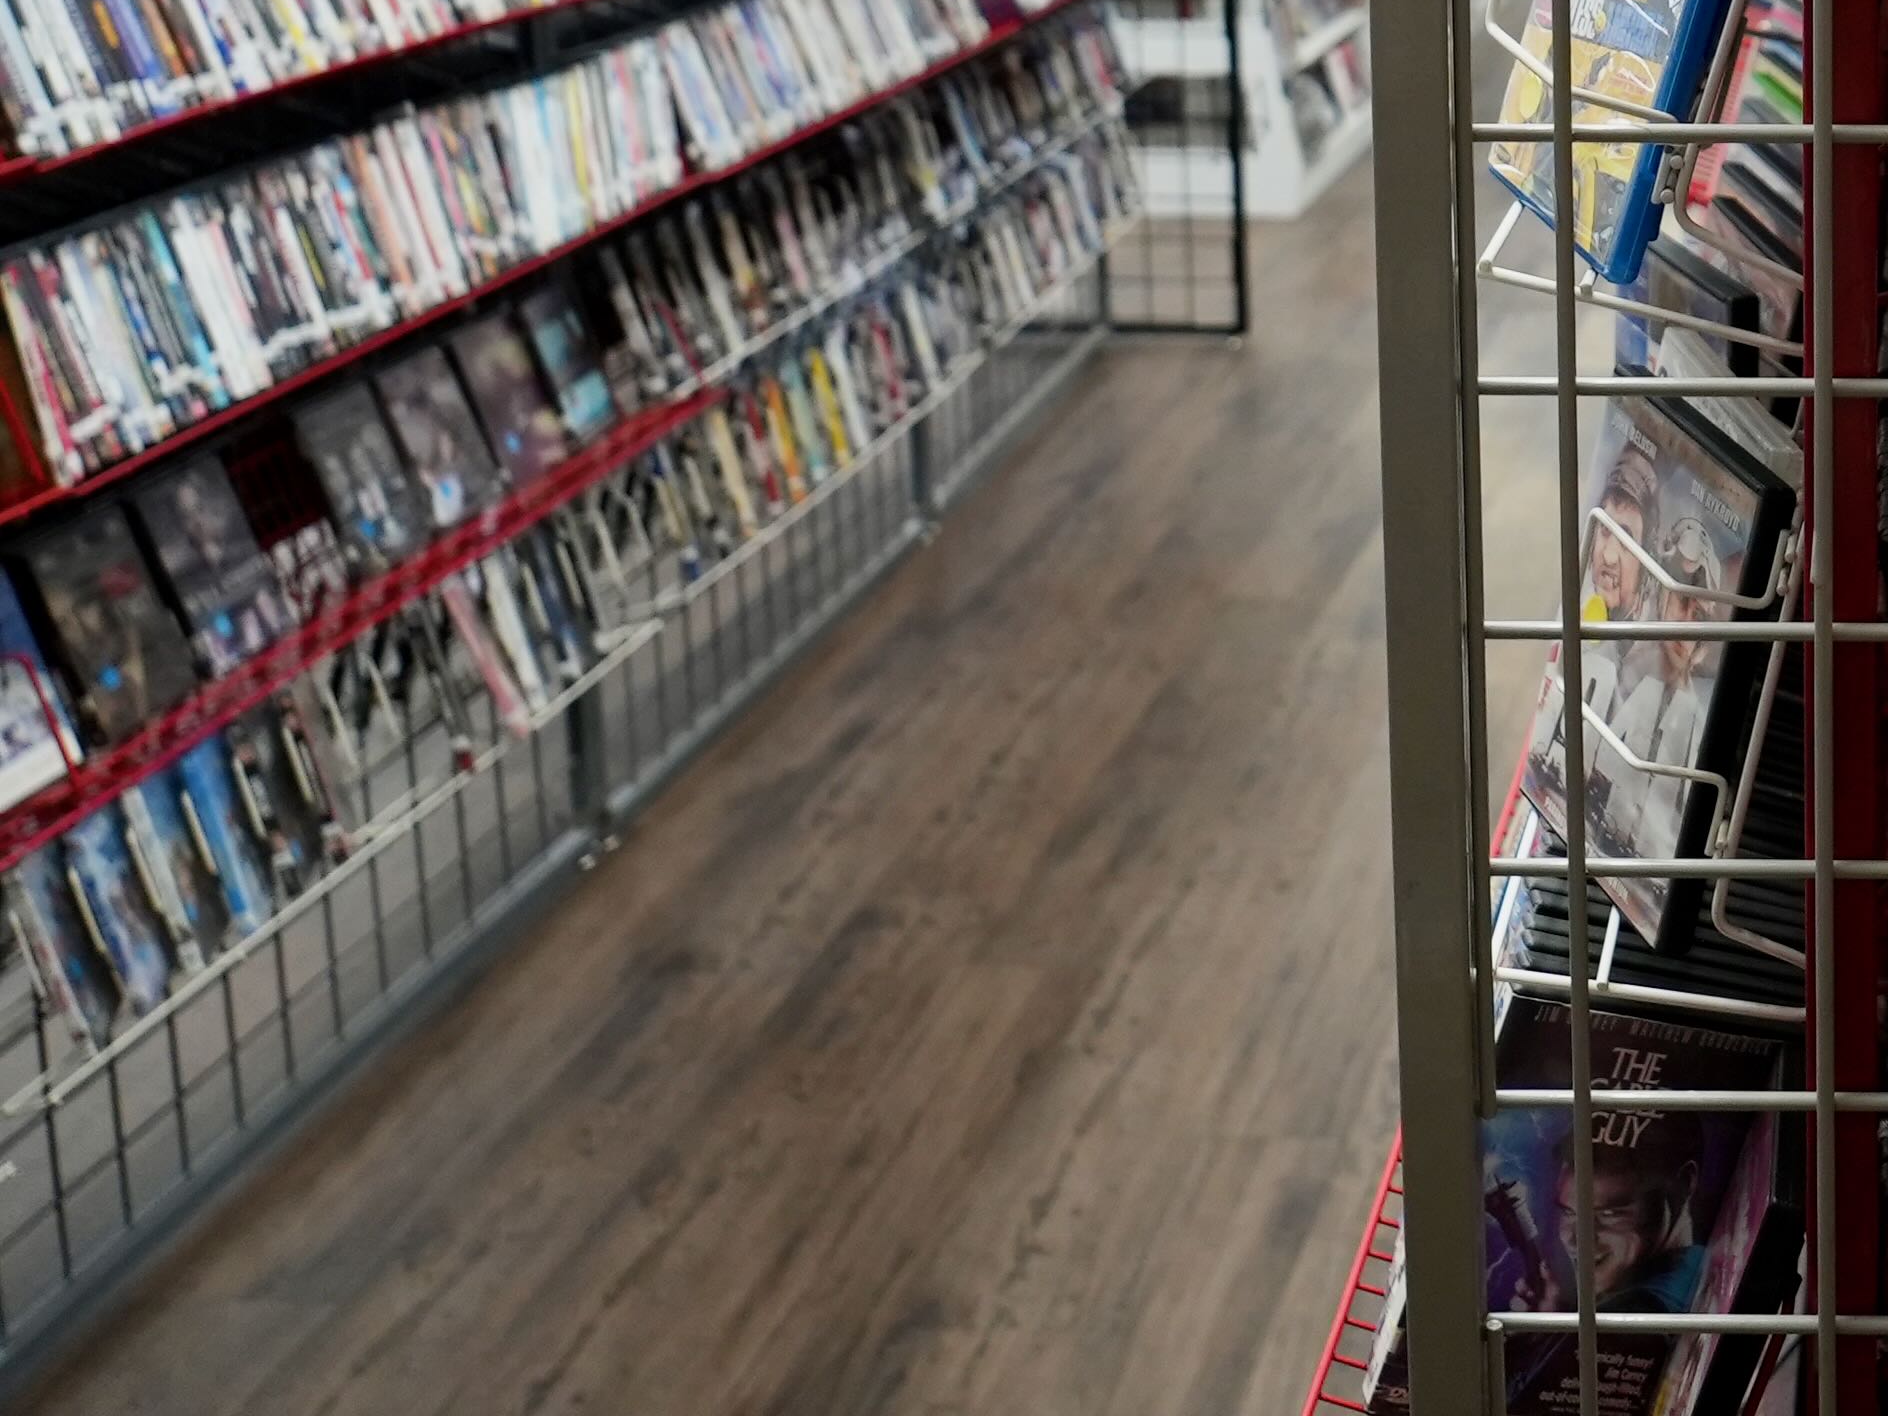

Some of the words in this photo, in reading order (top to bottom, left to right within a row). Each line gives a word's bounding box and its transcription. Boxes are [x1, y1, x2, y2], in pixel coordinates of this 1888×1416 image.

[1691, 479, 1705, 503] DAN
[1705, 492, 1740, 531] AYKROYD
[1611, 1046, 1669, 1086] THE
[1591, 1111, 1652, 1149] GUY
